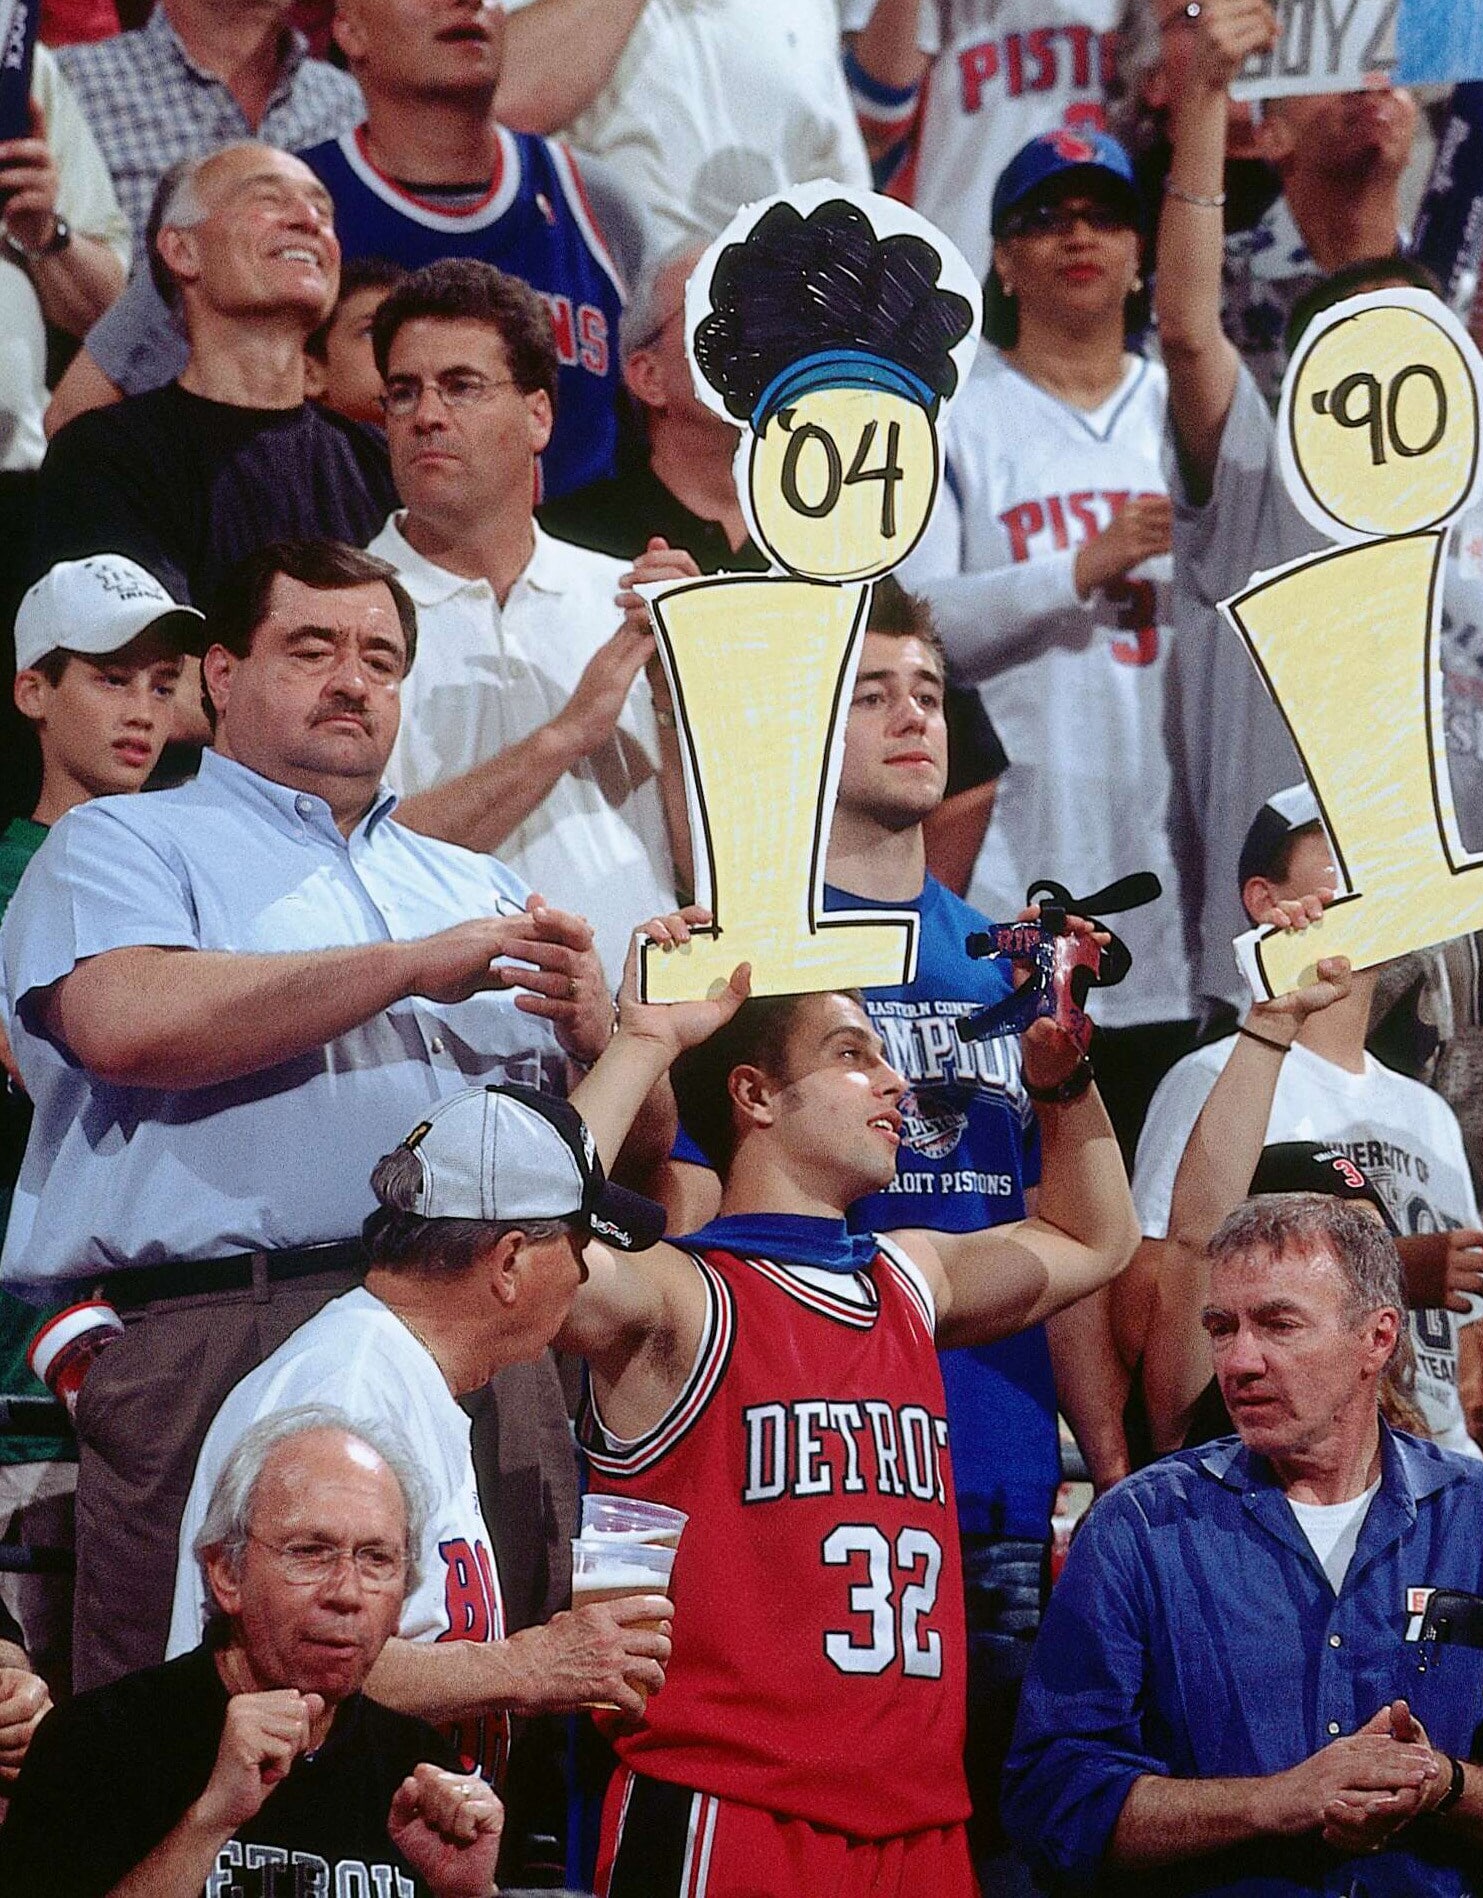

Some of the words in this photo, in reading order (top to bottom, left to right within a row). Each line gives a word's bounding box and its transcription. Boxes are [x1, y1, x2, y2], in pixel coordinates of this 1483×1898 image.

[1311, 363, 1448, 467] '90
[879, 1171, 935, 1194] ROIT
[940, 1170, 1013, 1196] PISTONS
[1332, 1157, 1366, 1188] 3
[821, 1522, 943, 1679] 32
